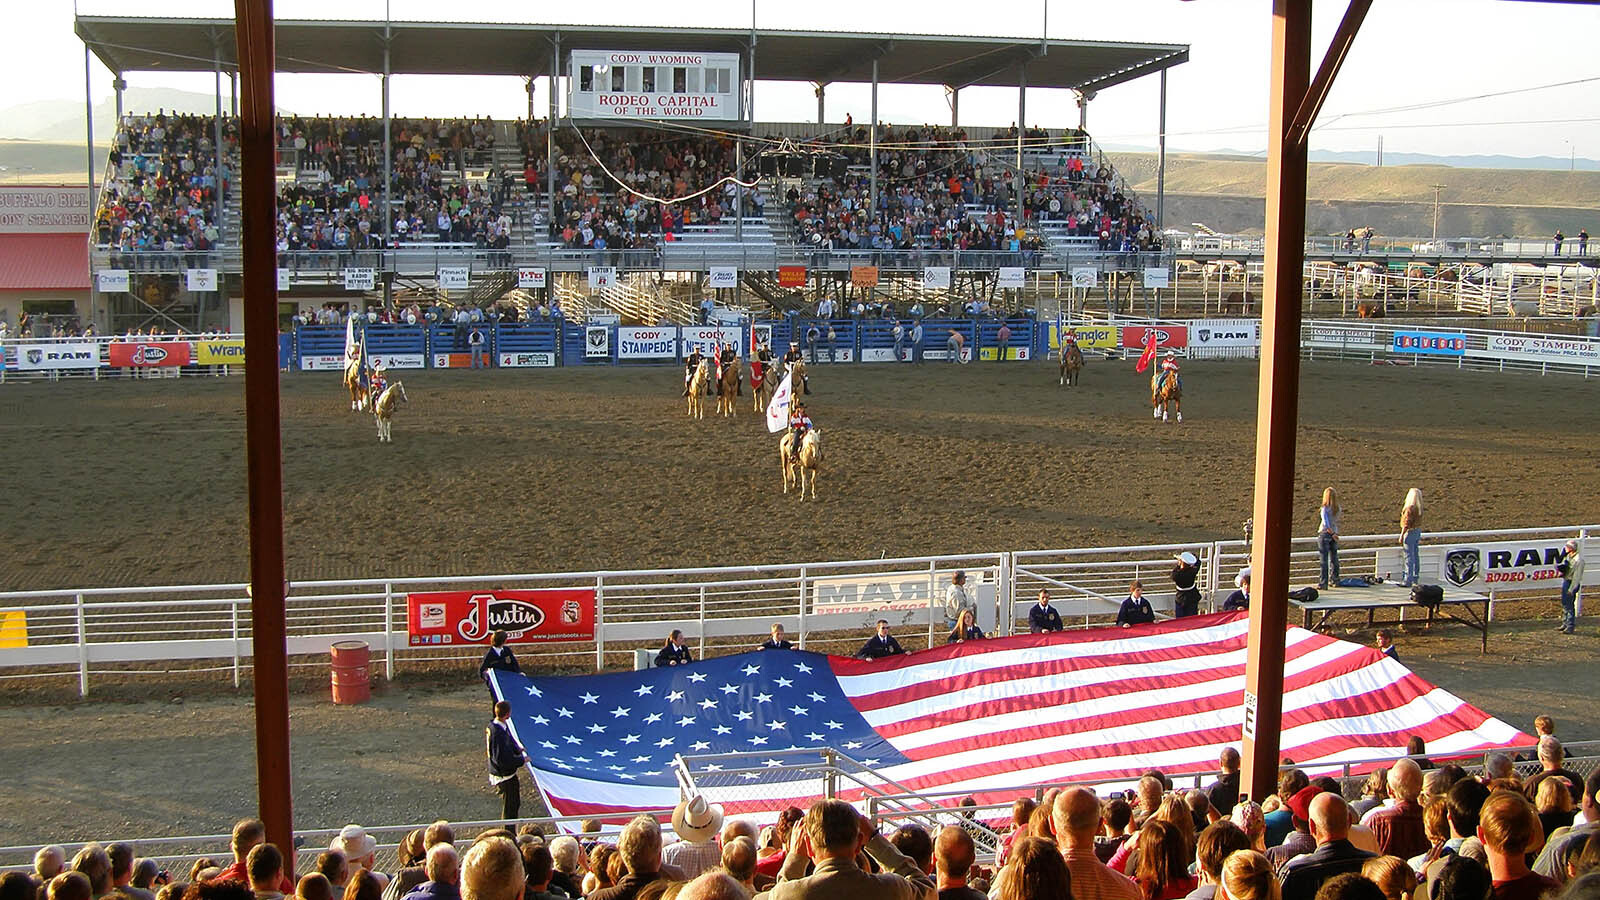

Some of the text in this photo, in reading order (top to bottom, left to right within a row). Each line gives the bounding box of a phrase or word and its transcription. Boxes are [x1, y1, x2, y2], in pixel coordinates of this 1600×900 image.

[648, 55, 702, 64] WYOMING
[599, 95, 718, 107] RODEO CAPITAL
[614, 107, 703, 116] OF THE WORLD
[0, 214, 89, 226] ODY STAMPED
[100, 275, 129, 284] Charter
[699, 331, 726, 339] CODY
[1214, 331, 1248, 339] RAM
[622, 340, 673, 354] STAMPEDE
[1396, 336, 1463, 349] LAS VEGAS
[1495, 337, 1595, 352] CODY STAMPEDE
[47, 351, 91, 360] RAM
[842, 352, 849, 360] 5
[1019, 351, 1026, 359] 8
[374, 359, 382, 368] 2
[438, 358, 446, 366] 3
[504, 357, 512, 365] 4
[1488, 548, 1566, 569] RAM
[1485, 571, 1525, 583] RODEO
[458, 594, 538, 642] Justin
[1245, 706, 1254, 735] E
